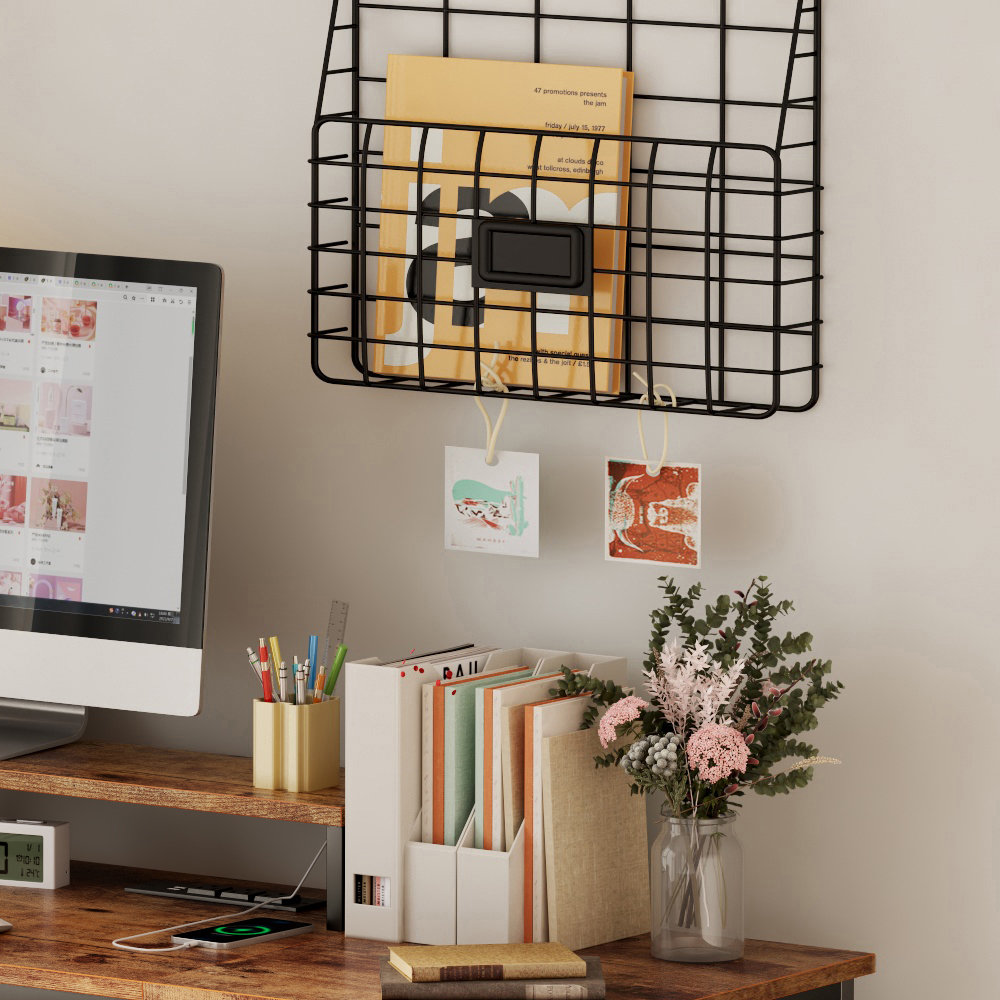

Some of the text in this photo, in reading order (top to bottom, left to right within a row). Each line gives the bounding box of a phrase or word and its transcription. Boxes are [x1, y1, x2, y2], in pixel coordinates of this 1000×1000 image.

[543, 88, 578, 96] promotions
[579, 90, 607, 98] presents
[545, 122, 562, 130] friday
[568, 123, 580, 131] july
[572, 167, 604, 175] edinbgh
